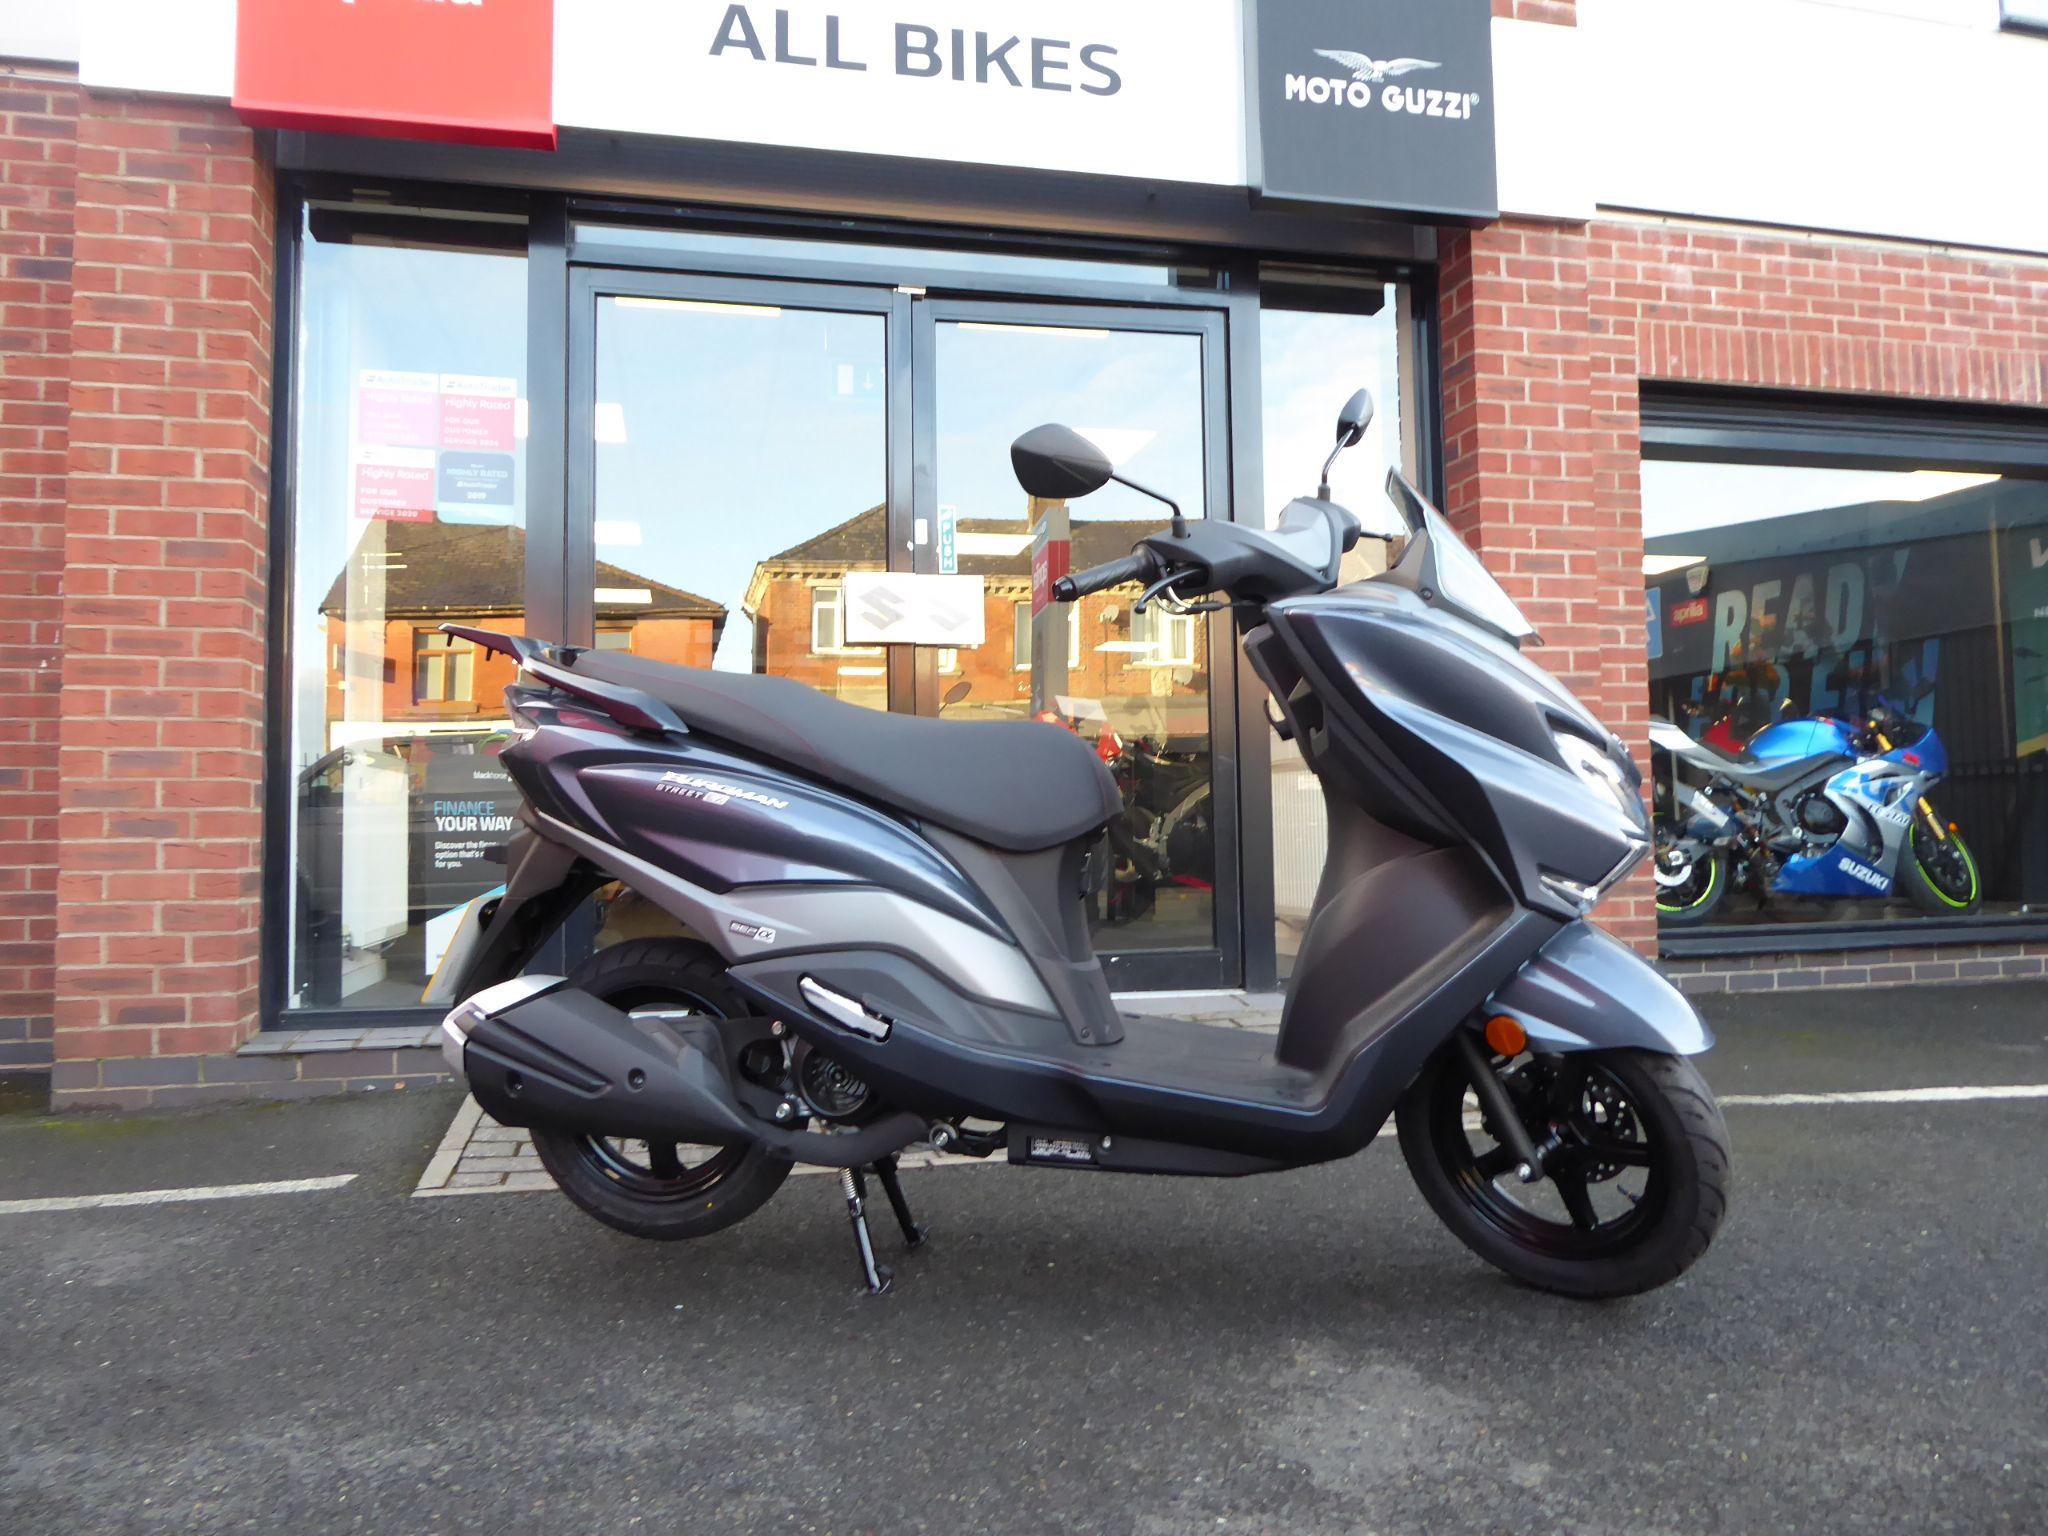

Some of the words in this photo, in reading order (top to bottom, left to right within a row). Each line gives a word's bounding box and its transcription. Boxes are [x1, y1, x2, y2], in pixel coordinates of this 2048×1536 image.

[708, 3, 867, 71] ALL
[895, 22, 1122, 96] BIKES
[1285, 73, 1371, 108] MOTO
[1673, 601, 1704, 624] aprilia
[656, 783, 703, 798] STREET
[660, 771, 789, 809] BURGMAN
[434, 800, 496, 815] FINANCE
[434, 816, 477, 831] YOUR
[480, 816, 514, 831] WAY
[435, 841, 466, 849] Discover
[466, 841, 478, 849] the
[435, 851, 458, 860] option
[459, 850, 480, 858] that's
[435, 860, 446, 868] for
[1838, 857, 1890, 891] SUZUKI
